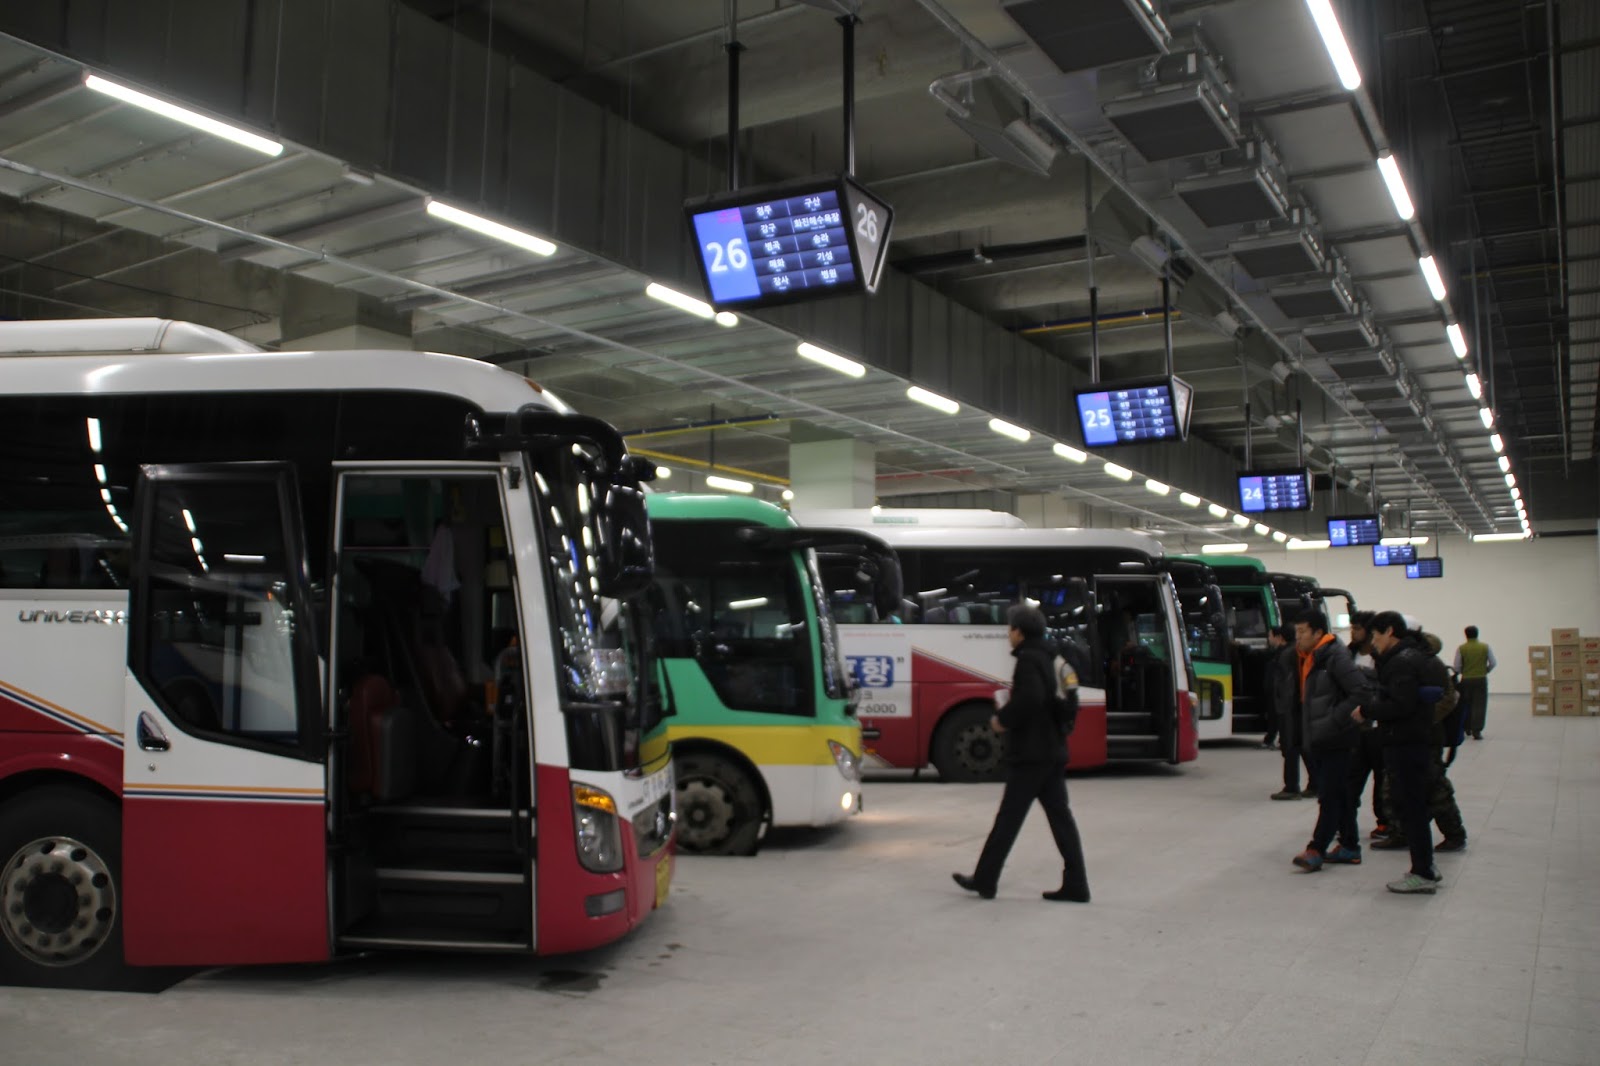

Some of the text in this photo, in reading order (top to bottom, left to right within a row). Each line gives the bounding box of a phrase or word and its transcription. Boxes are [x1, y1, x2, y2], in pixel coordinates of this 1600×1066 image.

[857, 202, 878, 243] 26
[706, 237, 748, 273] 26
[1084, 408, 1111, 428] 25
[1243, 487, 1263, 500] 24
[1331, 527, 1346, 538] 23
[1375, 551, 1387, 559] 22
[1407, 565, 1418, 573] 21
